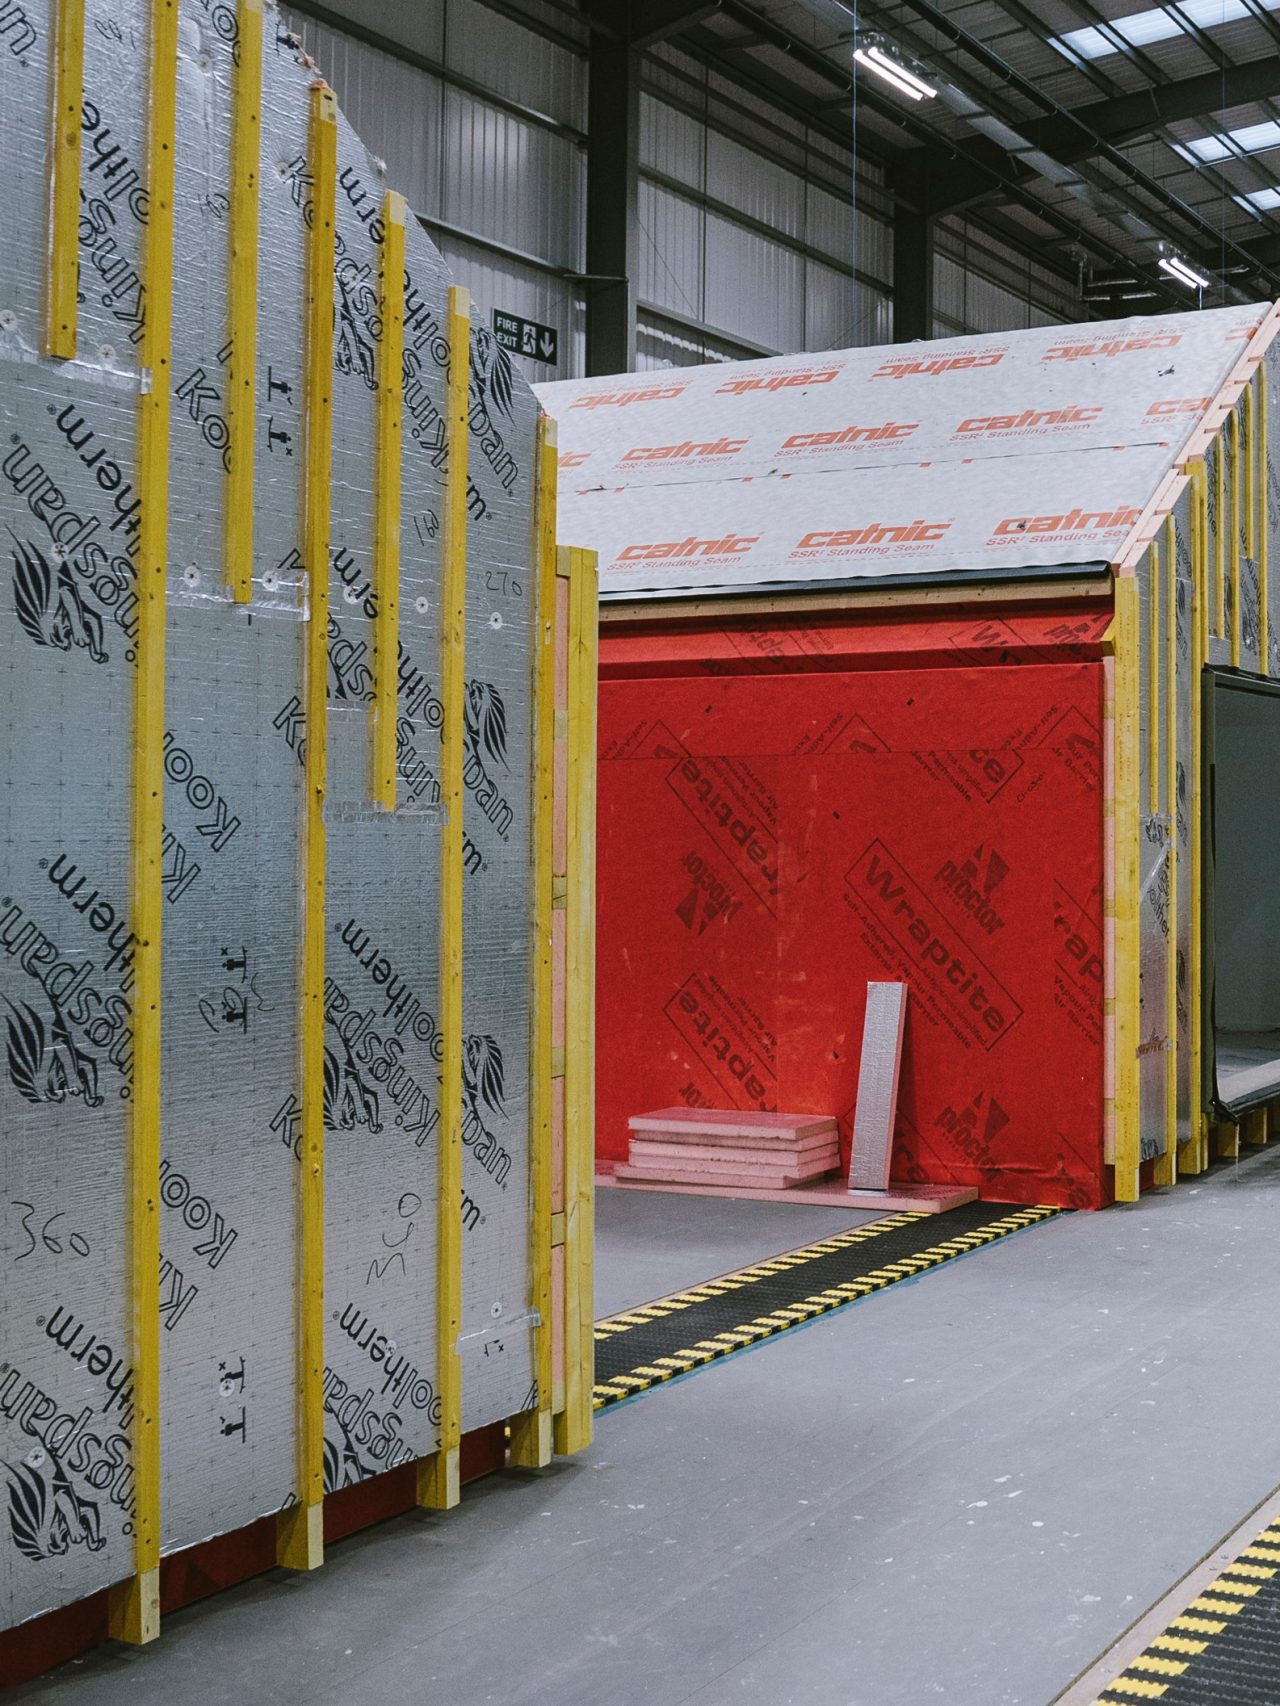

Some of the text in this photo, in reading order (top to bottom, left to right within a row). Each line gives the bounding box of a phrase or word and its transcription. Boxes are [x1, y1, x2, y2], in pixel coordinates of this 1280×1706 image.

[496, 316, 518, 333] FIRE
[495, 332, 518, 348] EXIT
[870, 354, 1005, 379] catnic
[714, 371, 840, 396] catnic
[956, 404, 1104, 432] catnic
[780, 422, 920, 448] catnic
[621, 437, 750, 461] catnic
[616, 534, 761, 561] catnic
[796, 520, 952, 549] catnic
[1029, 532, 1097, 543] Standing
[1102, 529, 1130, 537] Sea
[644, 557, 700, 569] Standing
[827, 545, 890, 556] Standing
[894, 543, 935, 552] Seam
[484, 570, 523, 597] 270
[681, 759, 779, 895] raptite
[933, 859, 1006, 935] proctor
[865, 854, 1005, 1033] Wraptite
[927, 994, 973, 1050] Permeable
[679, 990, 778, 1113] raptite
[12, 1201, 90, 1262] 360
